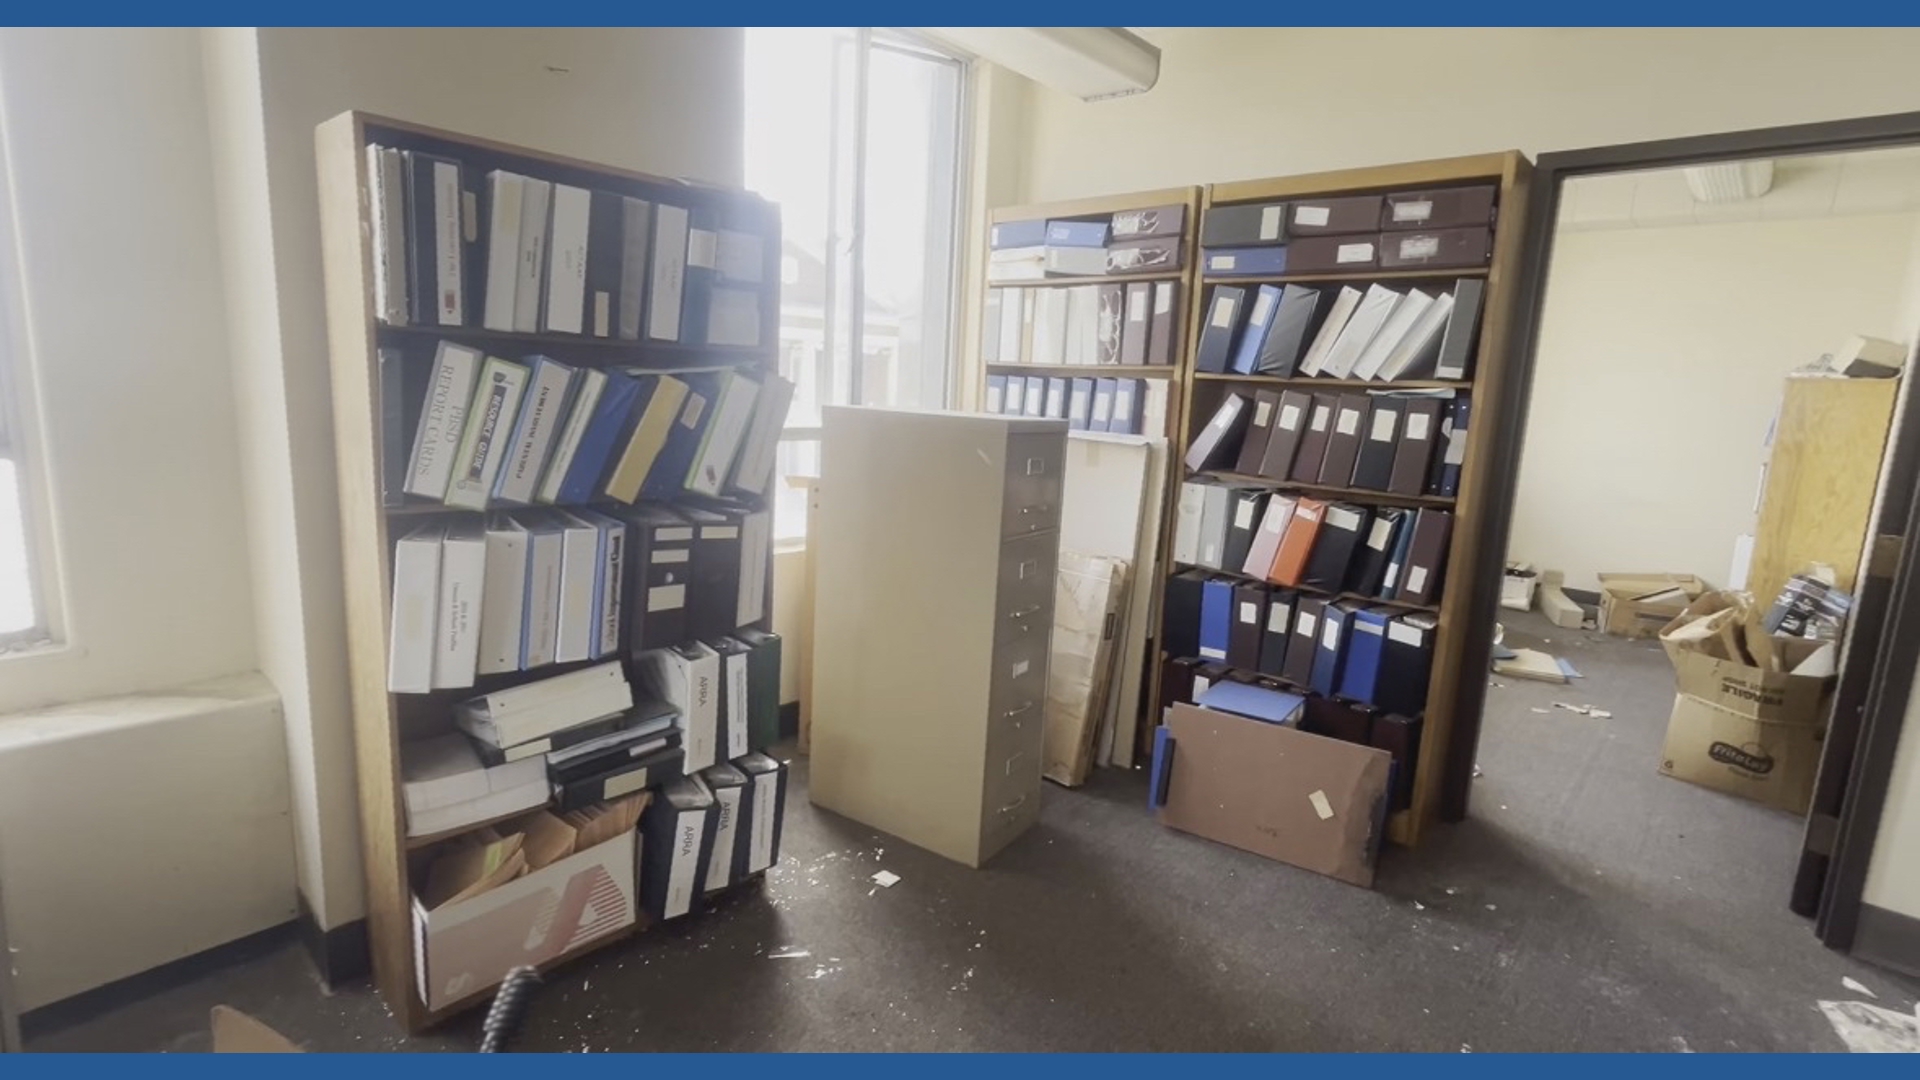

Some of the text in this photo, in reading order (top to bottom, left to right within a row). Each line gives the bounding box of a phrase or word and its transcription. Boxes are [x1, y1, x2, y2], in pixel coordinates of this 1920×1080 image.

[418, 365, 455, 477] REPORT CARDS
[472, 394, 502, 470] RESOURCE GUIDE
[699, 676, 708, 707] ARRA
[720, 801, 731, 832] ARRA
[681, 826, 695, 857] ARRA
